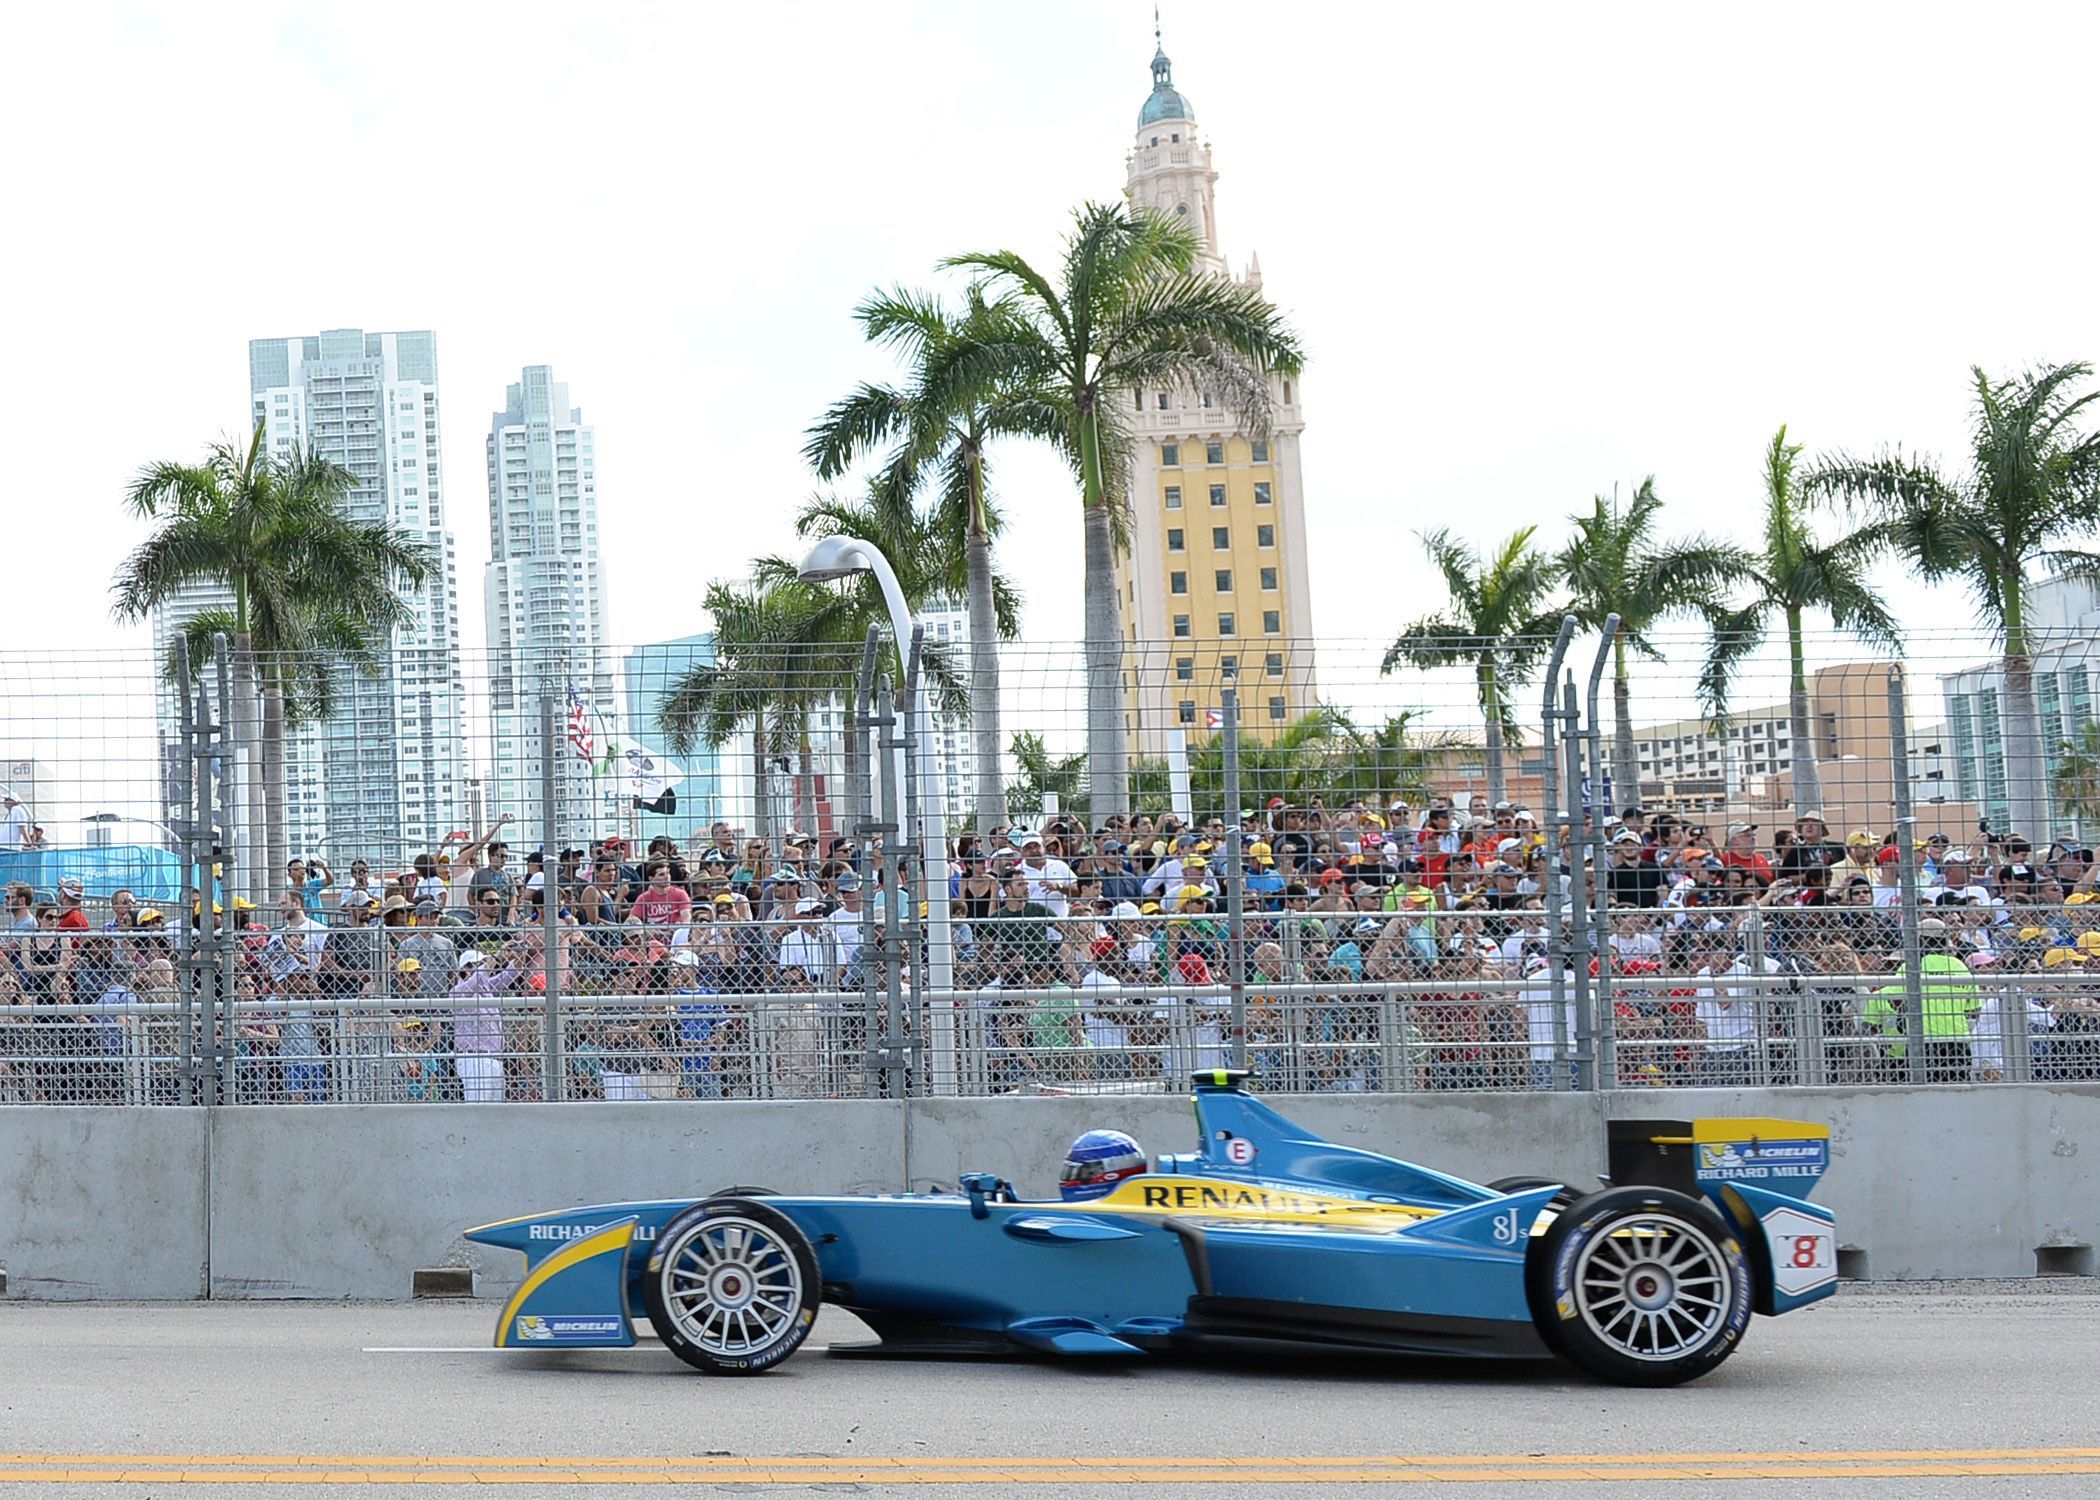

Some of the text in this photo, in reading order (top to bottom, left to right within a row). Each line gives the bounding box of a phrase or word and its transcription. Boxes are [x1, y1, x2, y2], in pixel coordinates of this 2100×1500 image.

[12, 763, 31, 775] citi
[1233, 1142, 1245, 1160] E
[1697, 1165, 1822, 1179] RICHARD MILLE
[1143, 1185, 1332, 1215] RENAULT
[1793, 1235, 1818, 1268] 8
[1734, 1265, 1749, 1330] MICHELIN
[552, 1322, 619, 1330] MICHELIN
[751, 1328, 802, 1367] MICHELIN
